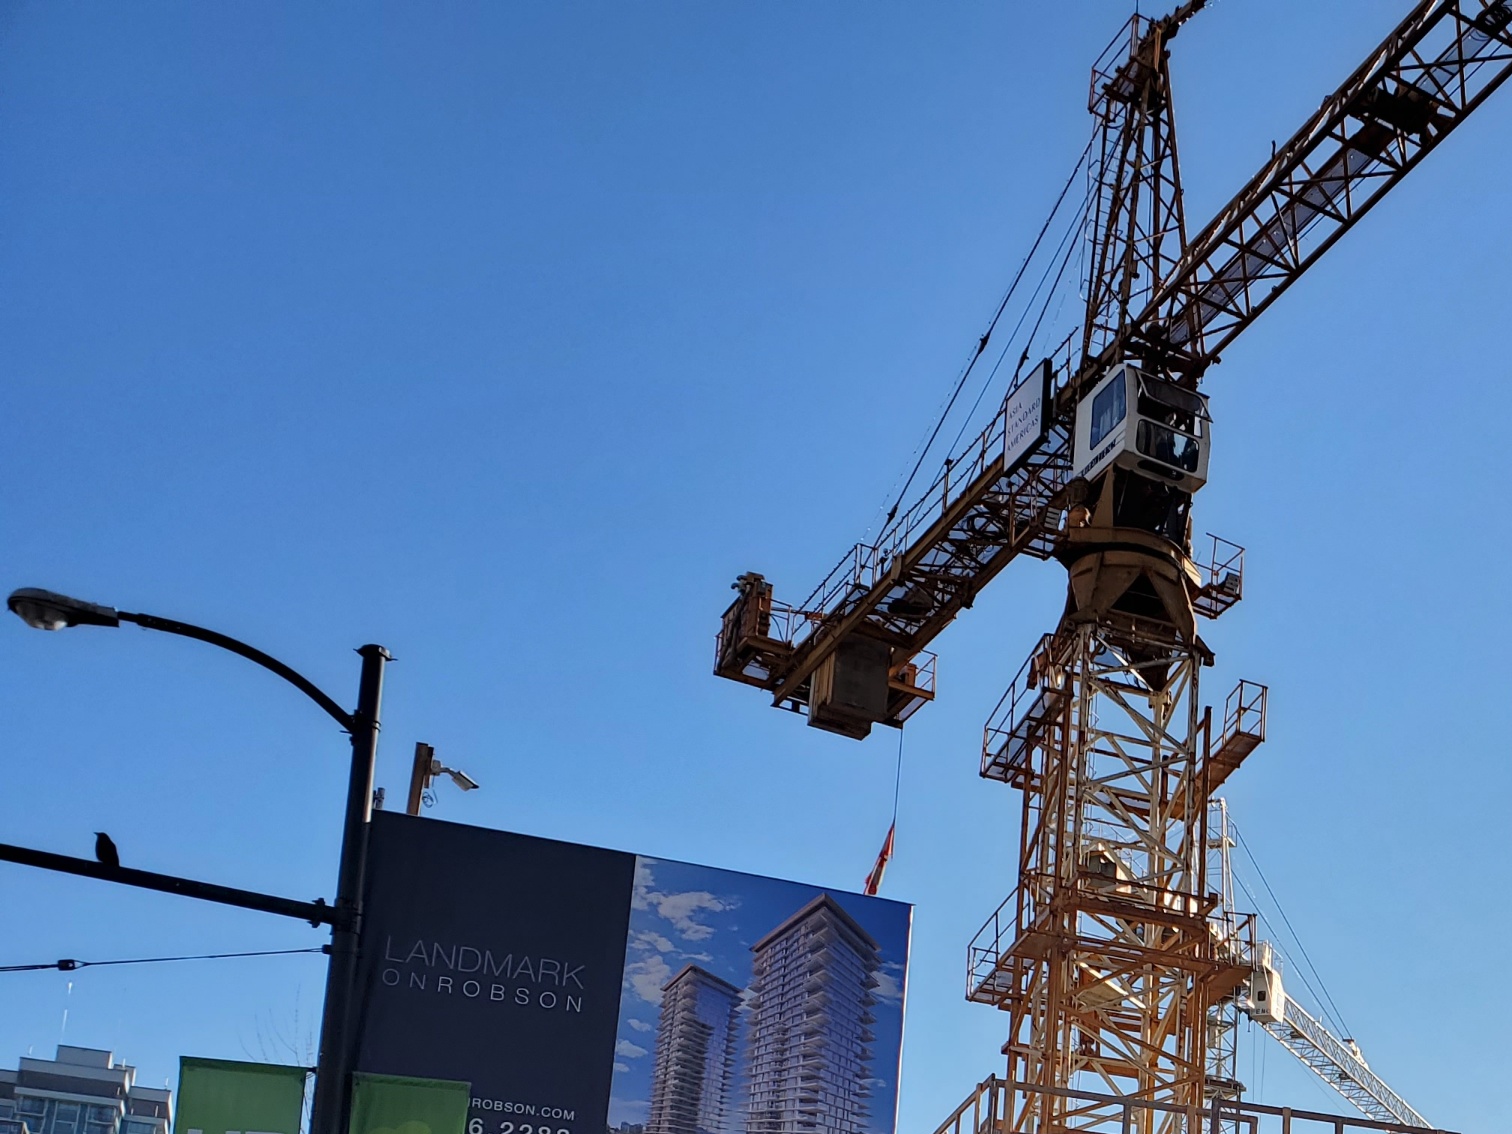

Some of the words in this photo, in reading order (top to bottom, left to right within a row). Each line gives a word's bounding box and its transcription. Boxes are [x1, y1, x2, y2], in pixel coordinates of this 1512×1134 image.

[1007, 397, 1041, 435] STANDARD
[1007, 415, 1039, 451] AMERICAS
[385, 935, 585, 989] LANDMARK
[468, 1097, 575, 1121] ROBSON.COM
